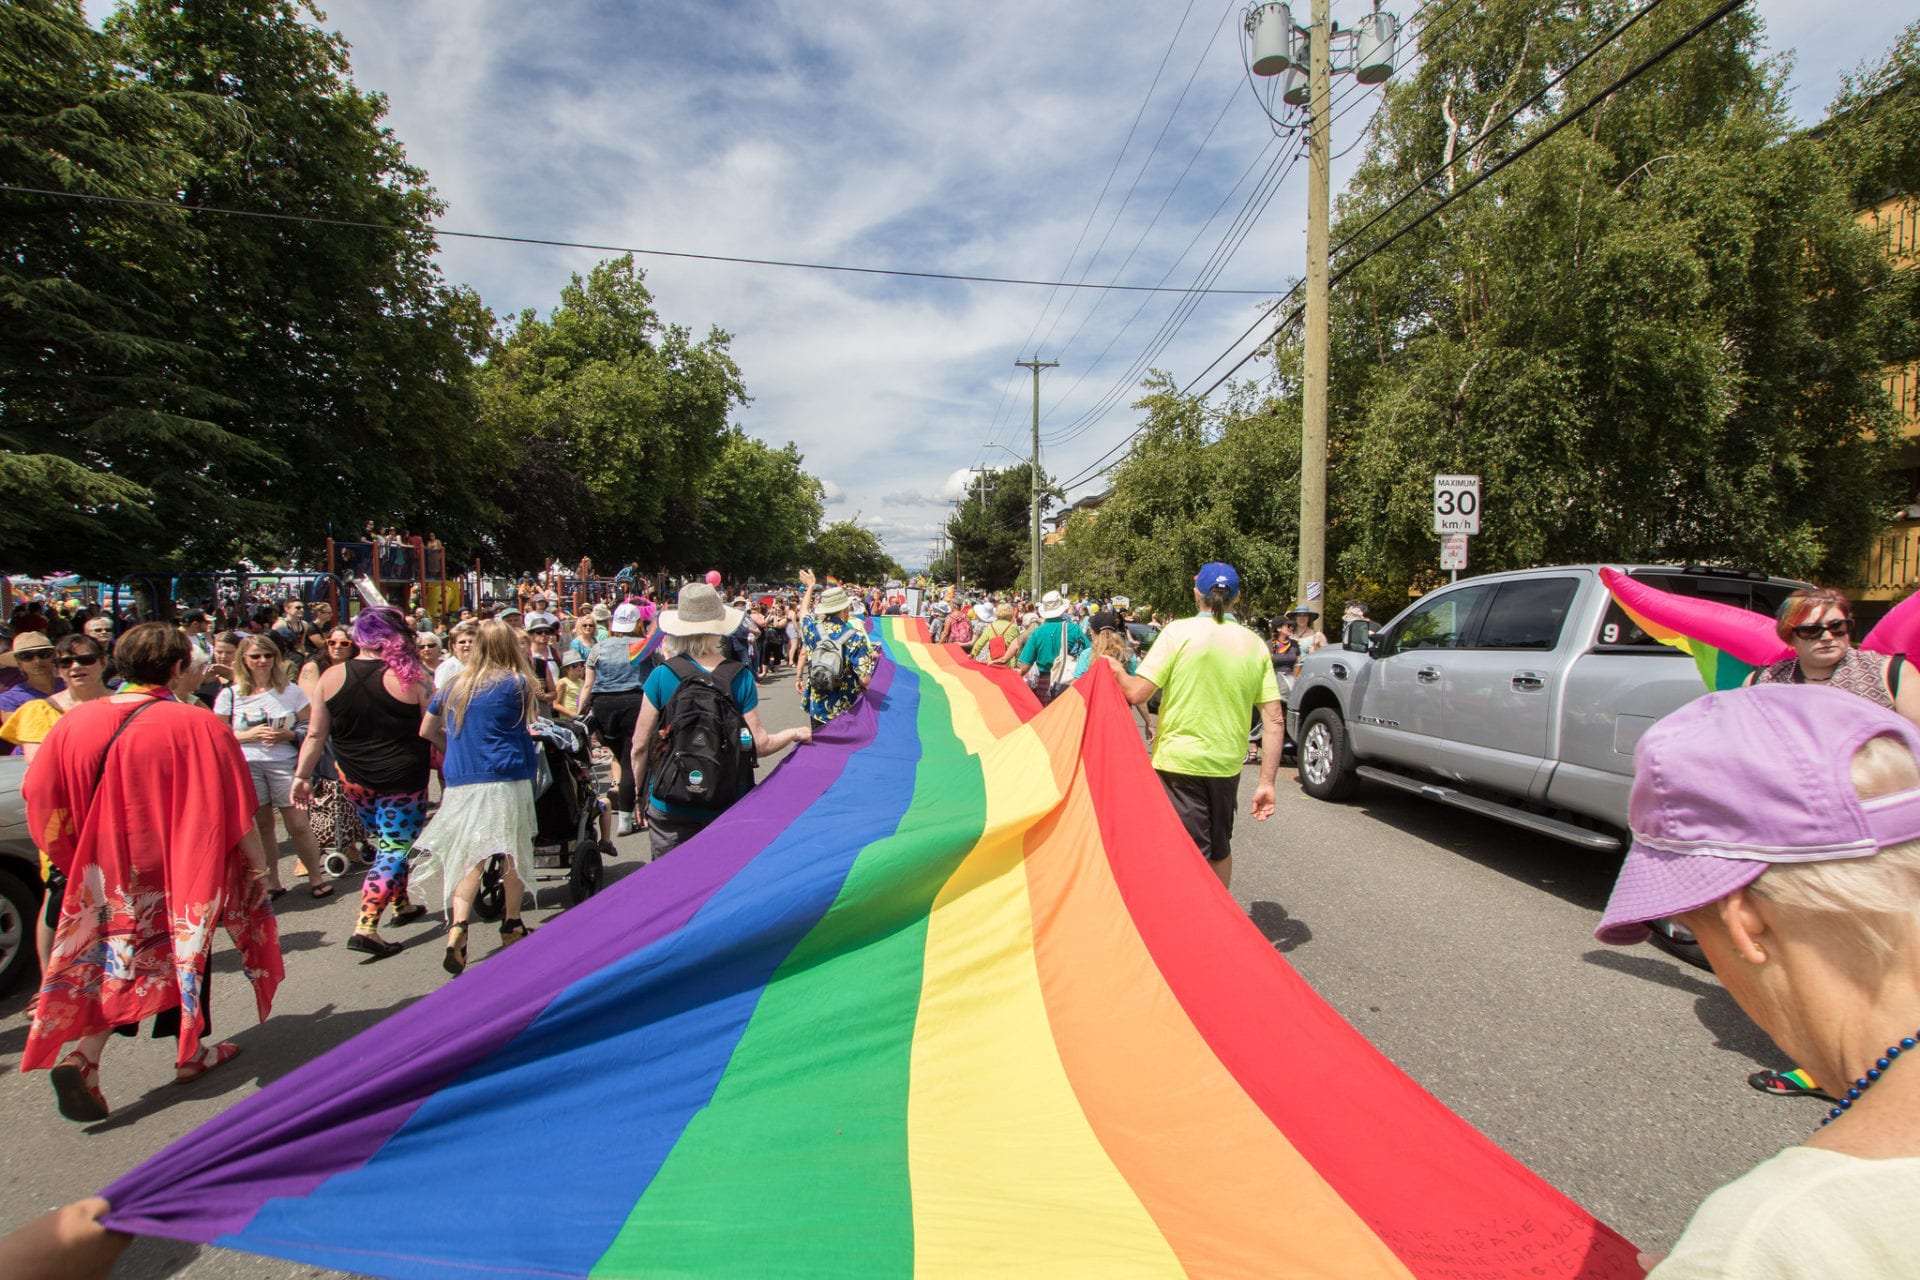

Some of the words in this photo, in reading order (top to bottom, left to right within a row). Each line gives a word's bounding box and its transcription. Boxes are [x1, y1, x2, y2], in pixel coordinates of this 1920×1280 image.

[1438, 479, 1476, 487] MAXIMUM
[1437, 490, 1476, 515] 30
[1442, 519, 1471, 529] km/h
[1603, 623, 1620, 643] 9
